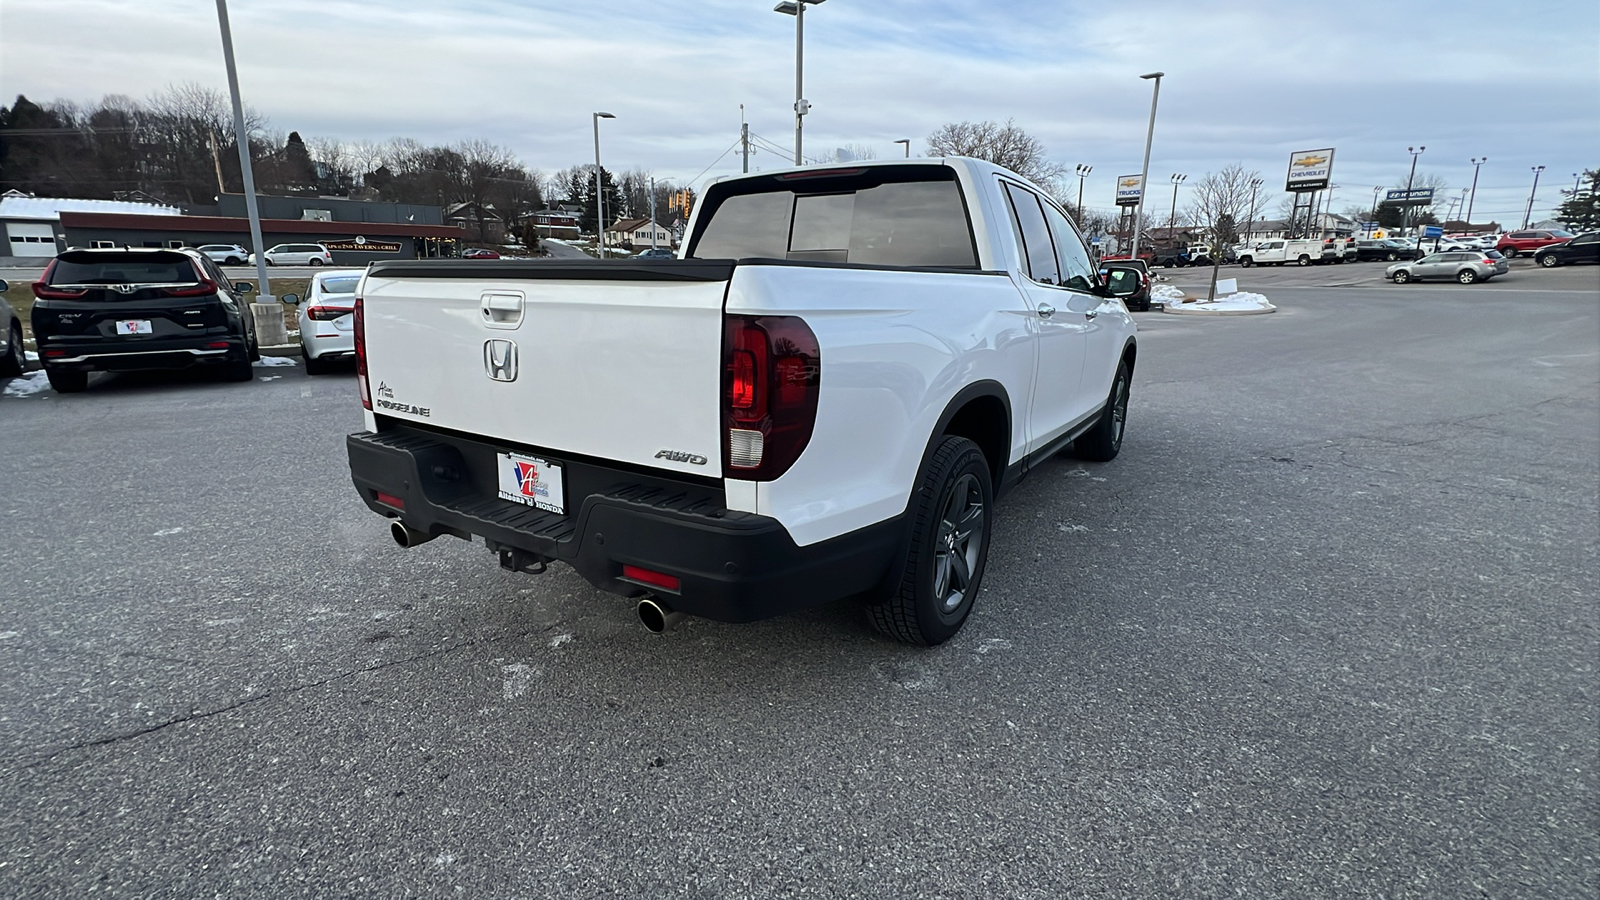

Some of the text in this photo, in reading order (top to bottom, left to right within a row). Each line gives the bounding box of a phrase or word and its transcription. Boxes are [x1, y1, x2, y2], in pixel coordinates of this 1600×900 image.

[1291, 170, 1326, 178] CHEVROLET
[377, 399, 430, 417] RIDGELINE
[654, 449, 708, 466] AWD
[536, 500, 564, 515] HONDA
